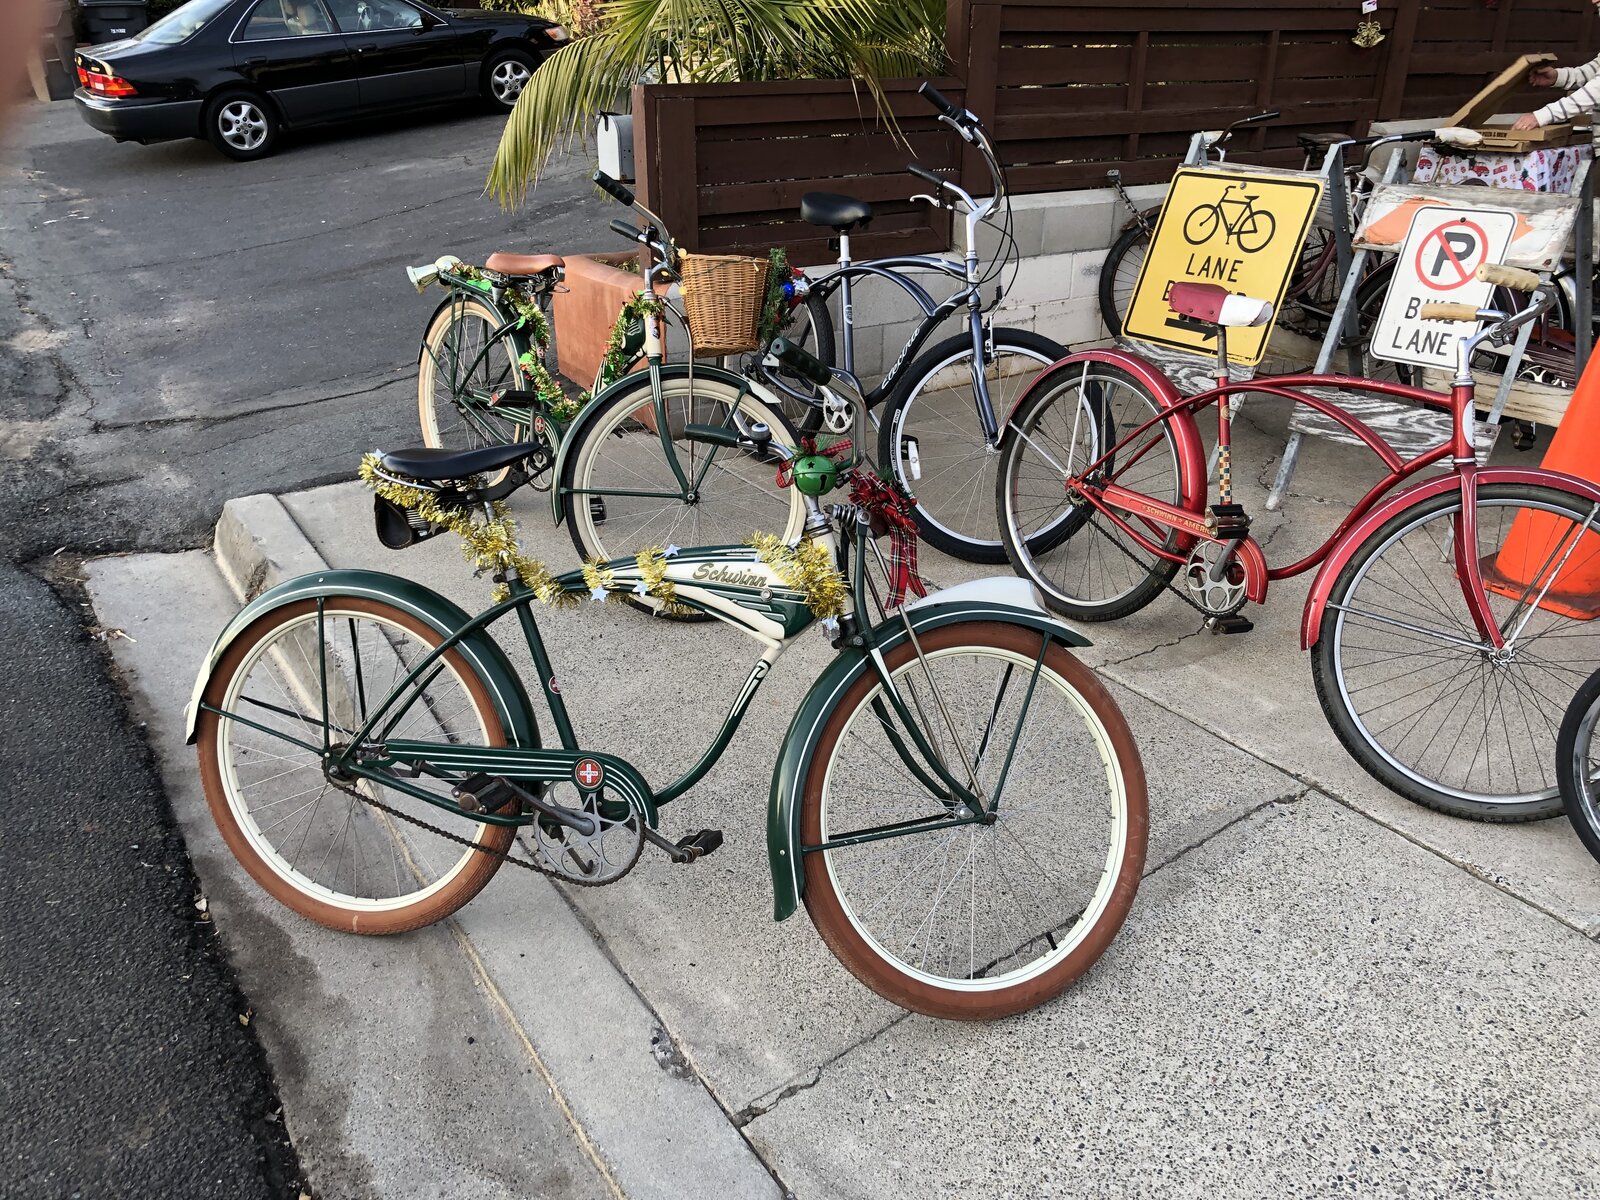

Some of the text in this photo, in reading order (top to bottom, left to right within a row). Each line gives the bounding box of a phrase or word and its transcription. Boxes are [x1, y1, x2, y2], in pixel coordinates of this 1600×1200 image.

[1185, 253, 1243, 282] LANE
[1391, 326, 1453, 356] LANE
[1146, 507, 1178, 522] SCHWINN
[692, 562, 768, 588] Schwinn
